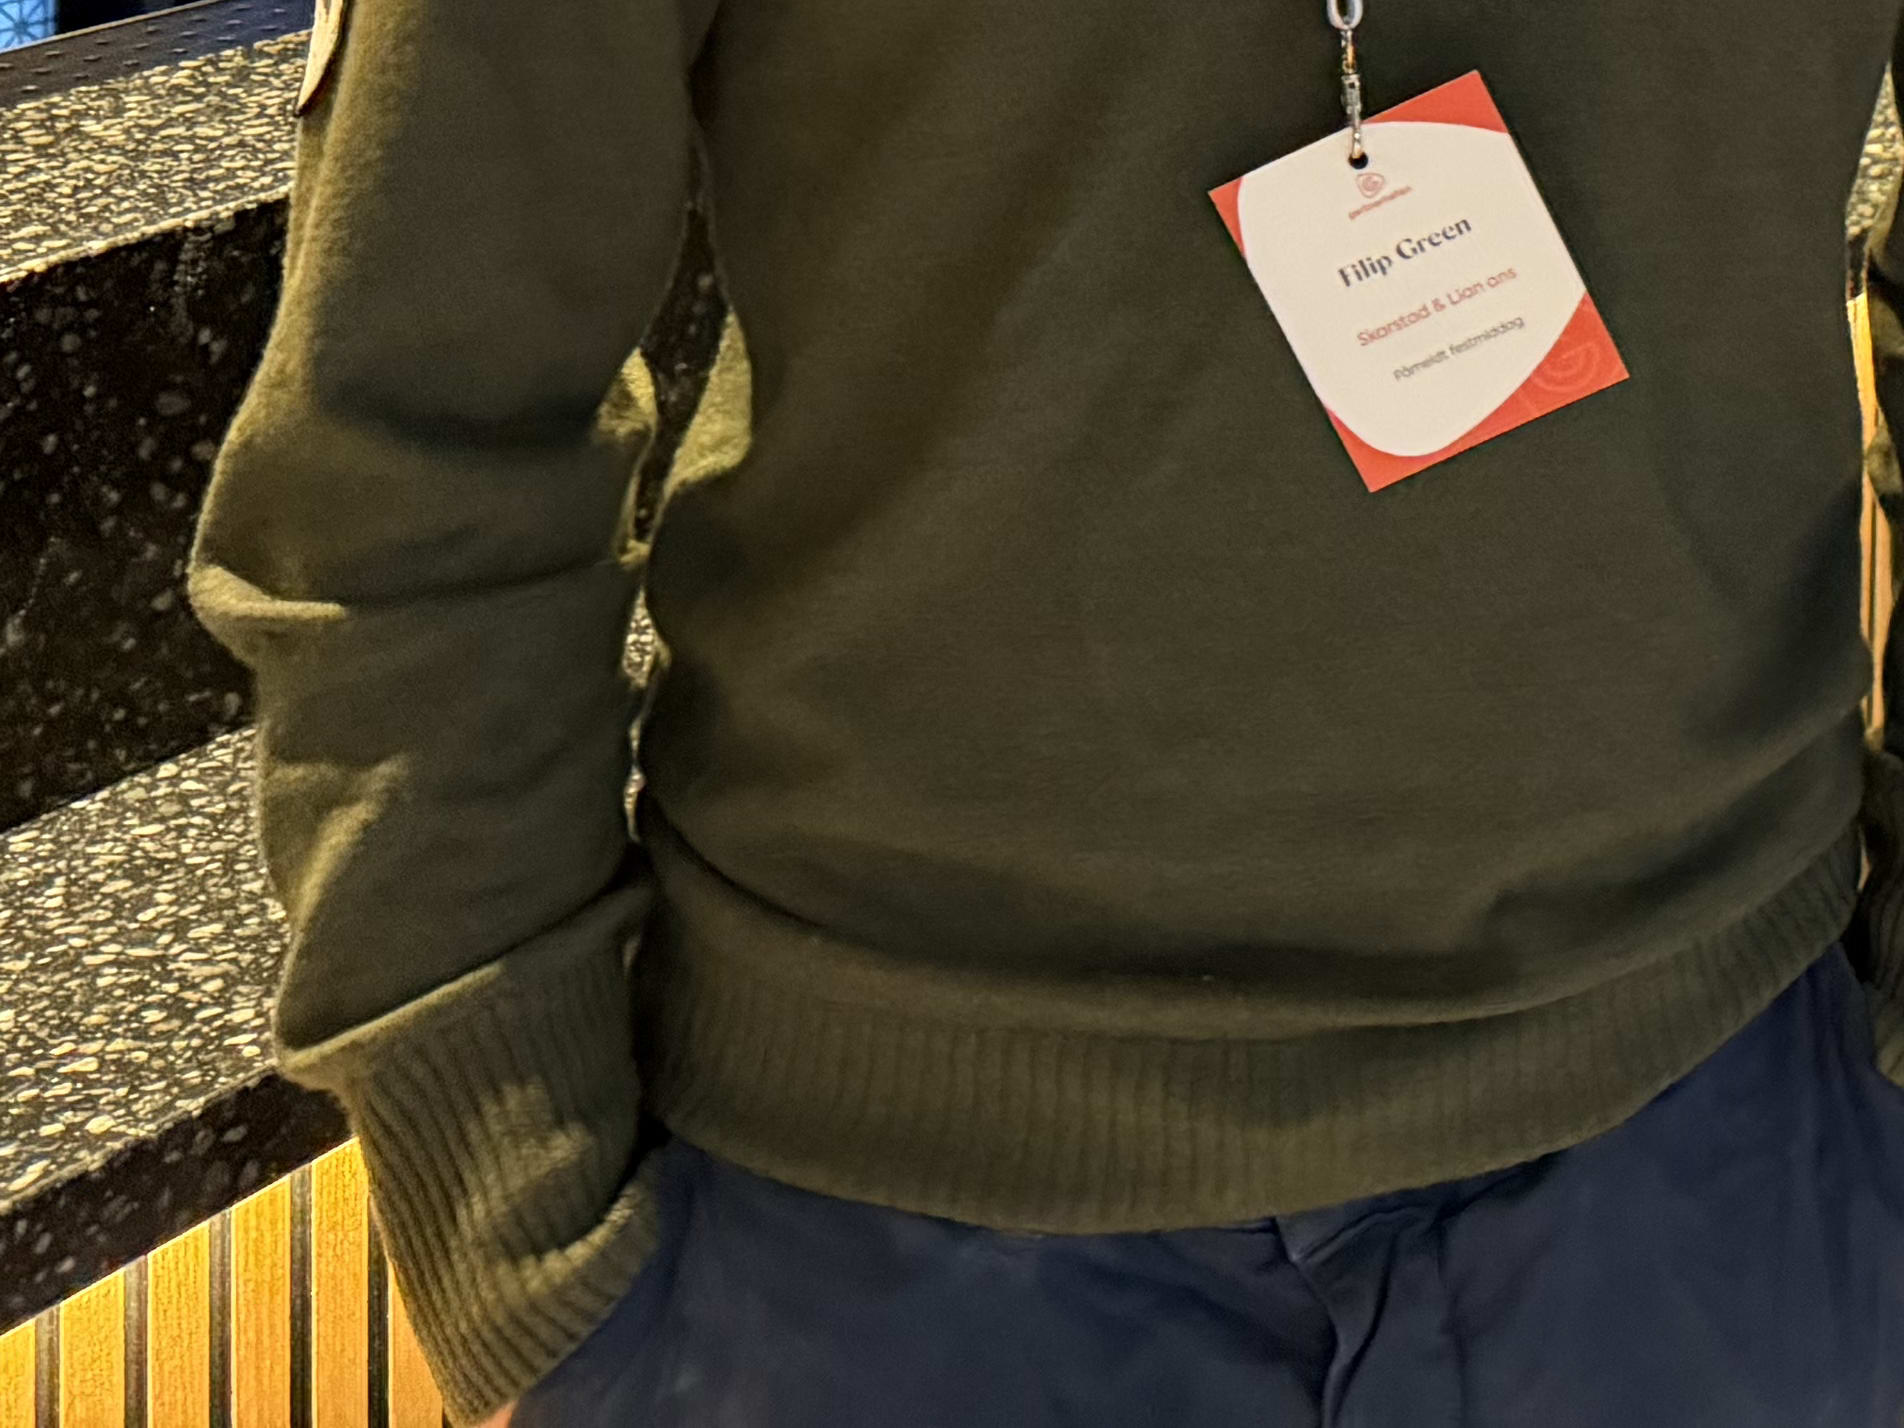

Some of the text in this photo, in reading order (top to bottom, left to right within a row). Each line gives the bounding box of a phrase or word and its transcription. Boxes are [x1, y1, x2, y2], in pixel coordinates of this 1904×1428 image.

[1338, 219, 1472, 287] Filip Green
[1432, 297, 1446, 313] &
[1447, 281, 1484, 306] Lian
[1487, 268, 1518, 289] ans
